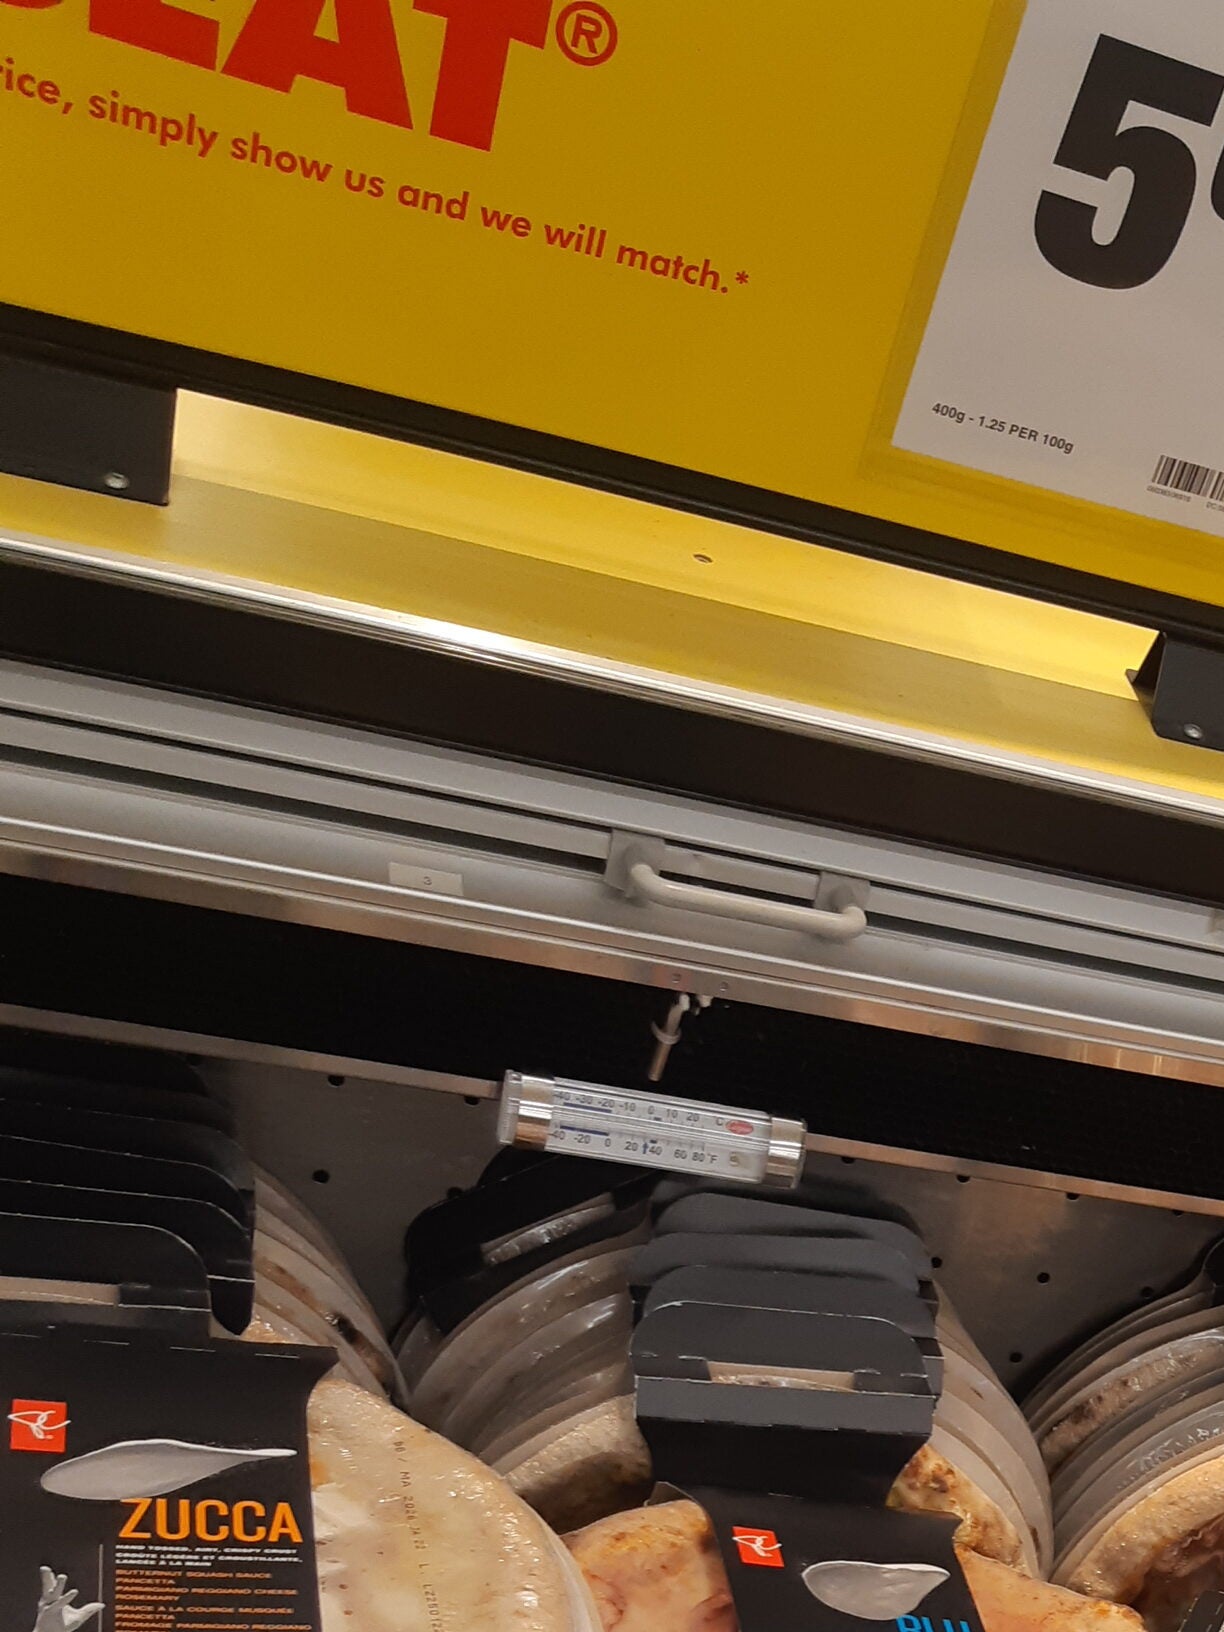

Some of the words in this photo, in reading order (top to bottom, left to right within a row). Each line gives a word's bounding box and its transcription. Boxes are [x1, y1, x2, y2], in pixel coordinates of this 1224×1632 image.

[0, 57, 75, 114] ice,
[88, 91, 219, 158] simply
[230, 132, 332, 183] show
[345, 168, 385, 198] us
[398, 183, 469, 220] and
[480, 206, 532, 238] we
[544, 222, 607, 258] will
[930, 401, 965, 423] 400g
[976, 414, 1006, 433] 1.25
[1007, 423, 1039, 443] PER
[1041, 433, 1075, 455] 100g
[574, 1094, 592, 1105] -30
[596, 1097, 615, 1108] -20
[618, 1100, 636, 1112] -10
[647, 1106, 655, 1115] 0
[665, 1108, 677, 1120] 10
[685, 1112, 699, 1122] 20
[573, 1132, 590, 1144] -20
[603, 1137, 611, 1148] 0
[623, 1141, 637, 1152] 20
[647, 1144, 662, 1156] 40
[673, 1149, 688, 1160] 60
[691, 1152, 704, 1162] 80
[117, 1498, 303, 1543] ZUCCA
